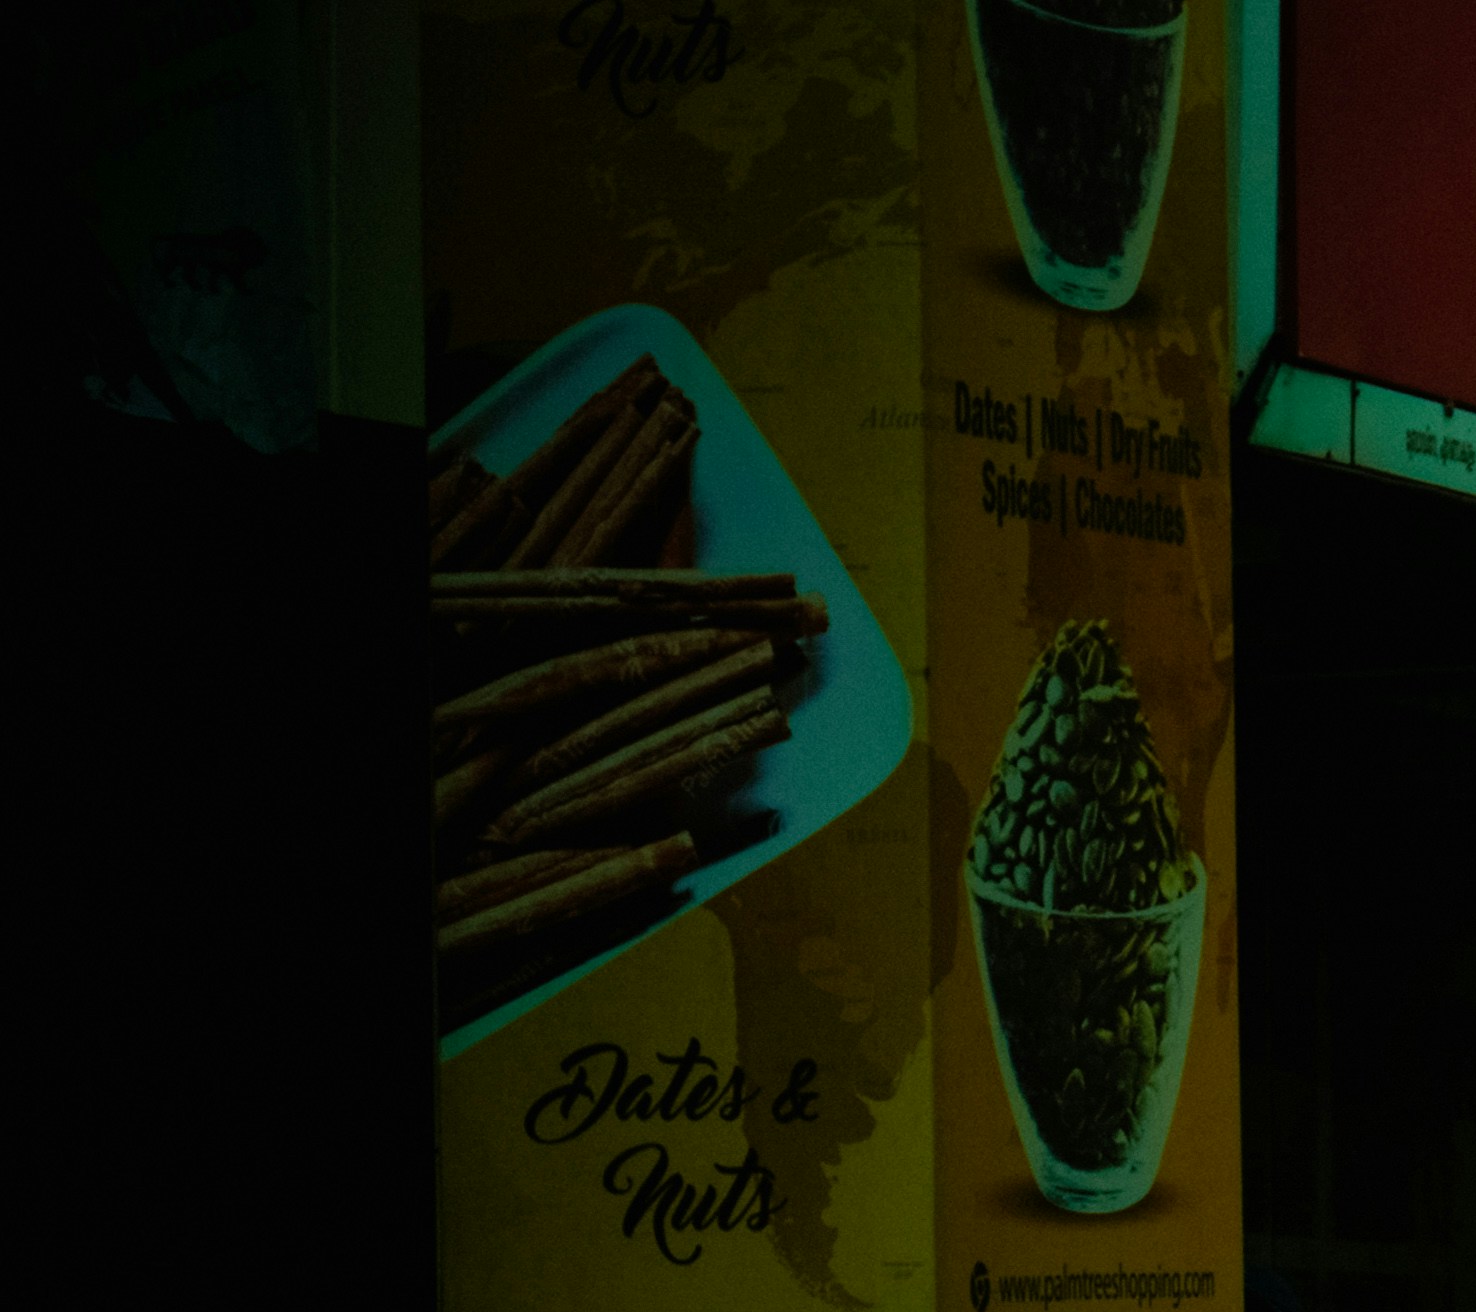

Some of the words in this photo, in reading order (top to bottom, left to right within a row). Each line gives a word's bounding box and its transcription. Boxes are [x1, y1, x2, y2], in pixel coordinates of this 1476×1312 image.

[556, 0, 746, 118] Nuts
[953, 381, 1018, 443] Dates
[1040, 390, 1089, 455] Nuts
[982, 460, 1052, 528] Spices
[1074, 486, 1185, 547] Chocolates
[523, 1036, 761, 1146] Dates
[771, 1056, 821, 1125] &
[602, 1142, 789, 1267] Nuts
